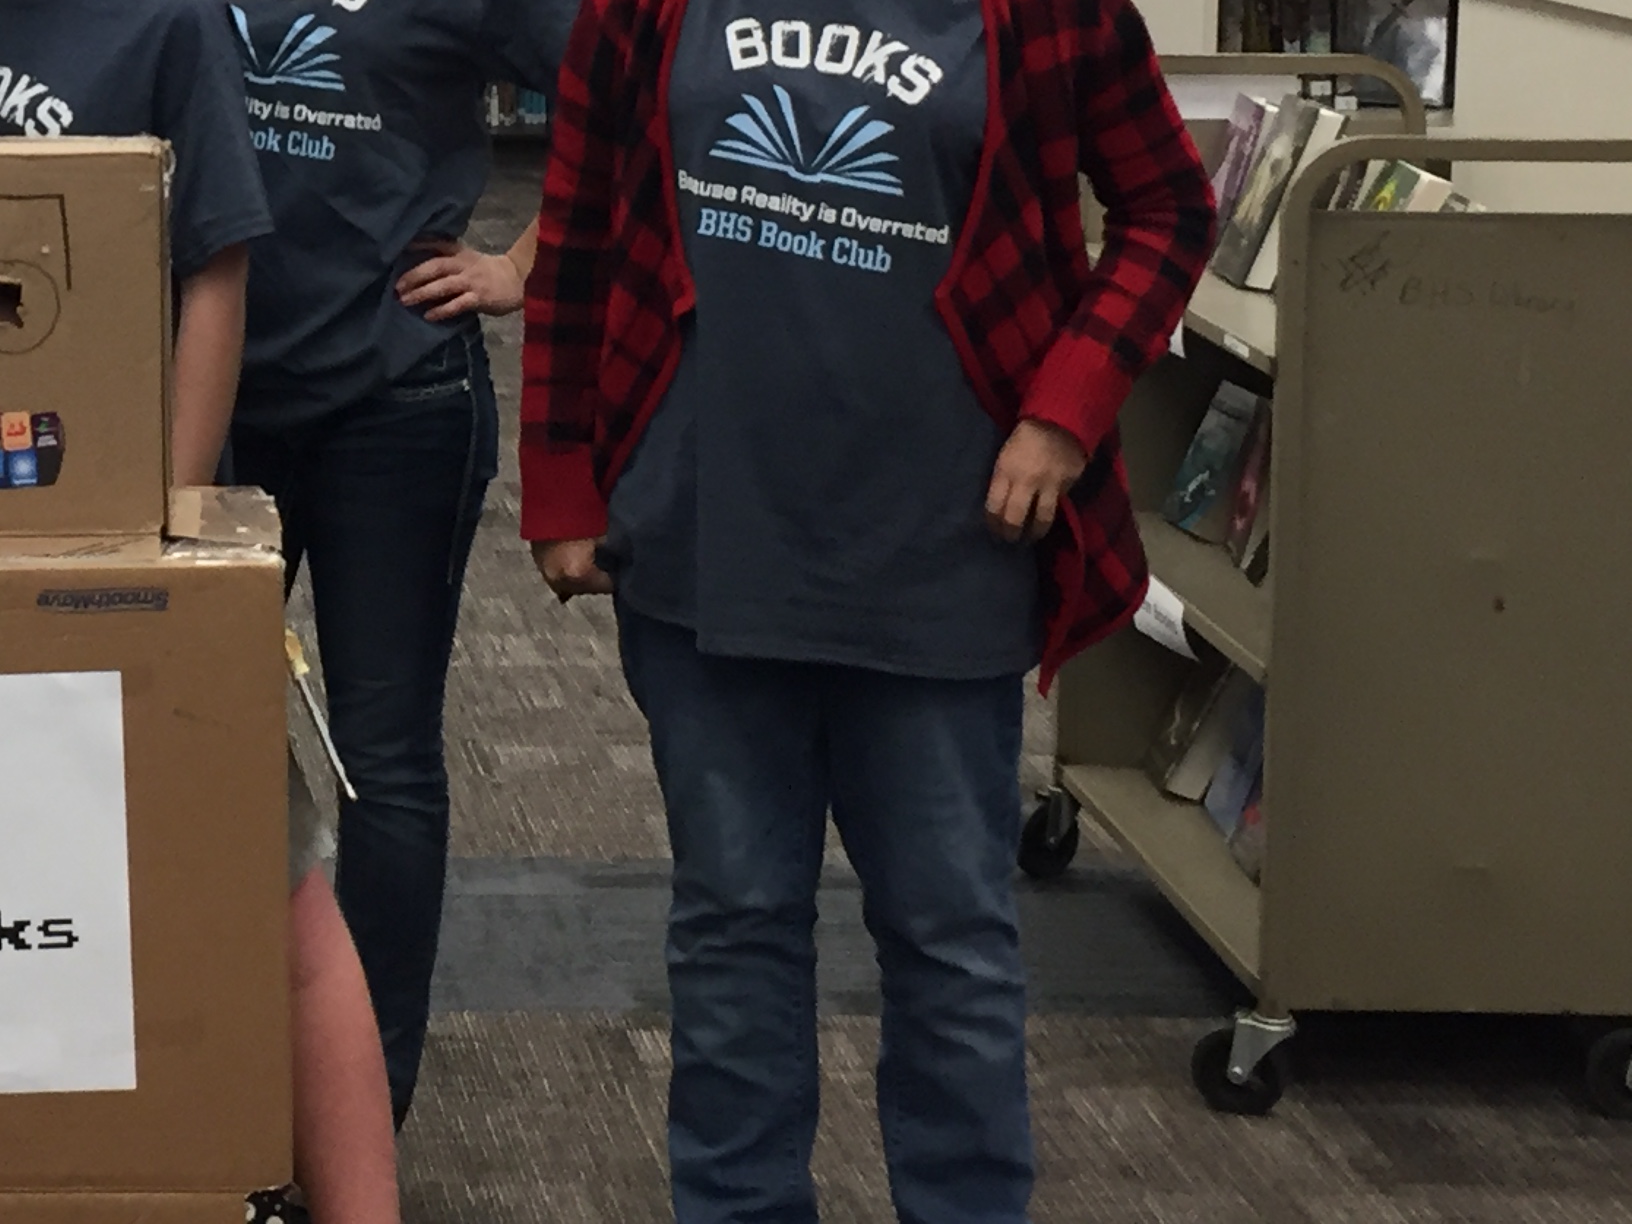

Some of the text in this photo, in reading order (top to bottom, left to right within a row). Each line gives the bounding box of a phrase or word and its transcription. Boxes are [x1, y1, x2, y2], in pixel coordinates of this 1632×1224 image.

[725, 17, 943, 105] BOOKS
[250, 127, 337, 161] ok Club
[274, 100, 291, 119] is
[292, 103, 383, 132] Overrated
[696, 207, 893, 274] BHS Book Club
[740, 184, 816, 223] Reality
[817, 202, 837, 224] is
[840, 206, 951, 245] Overrated
